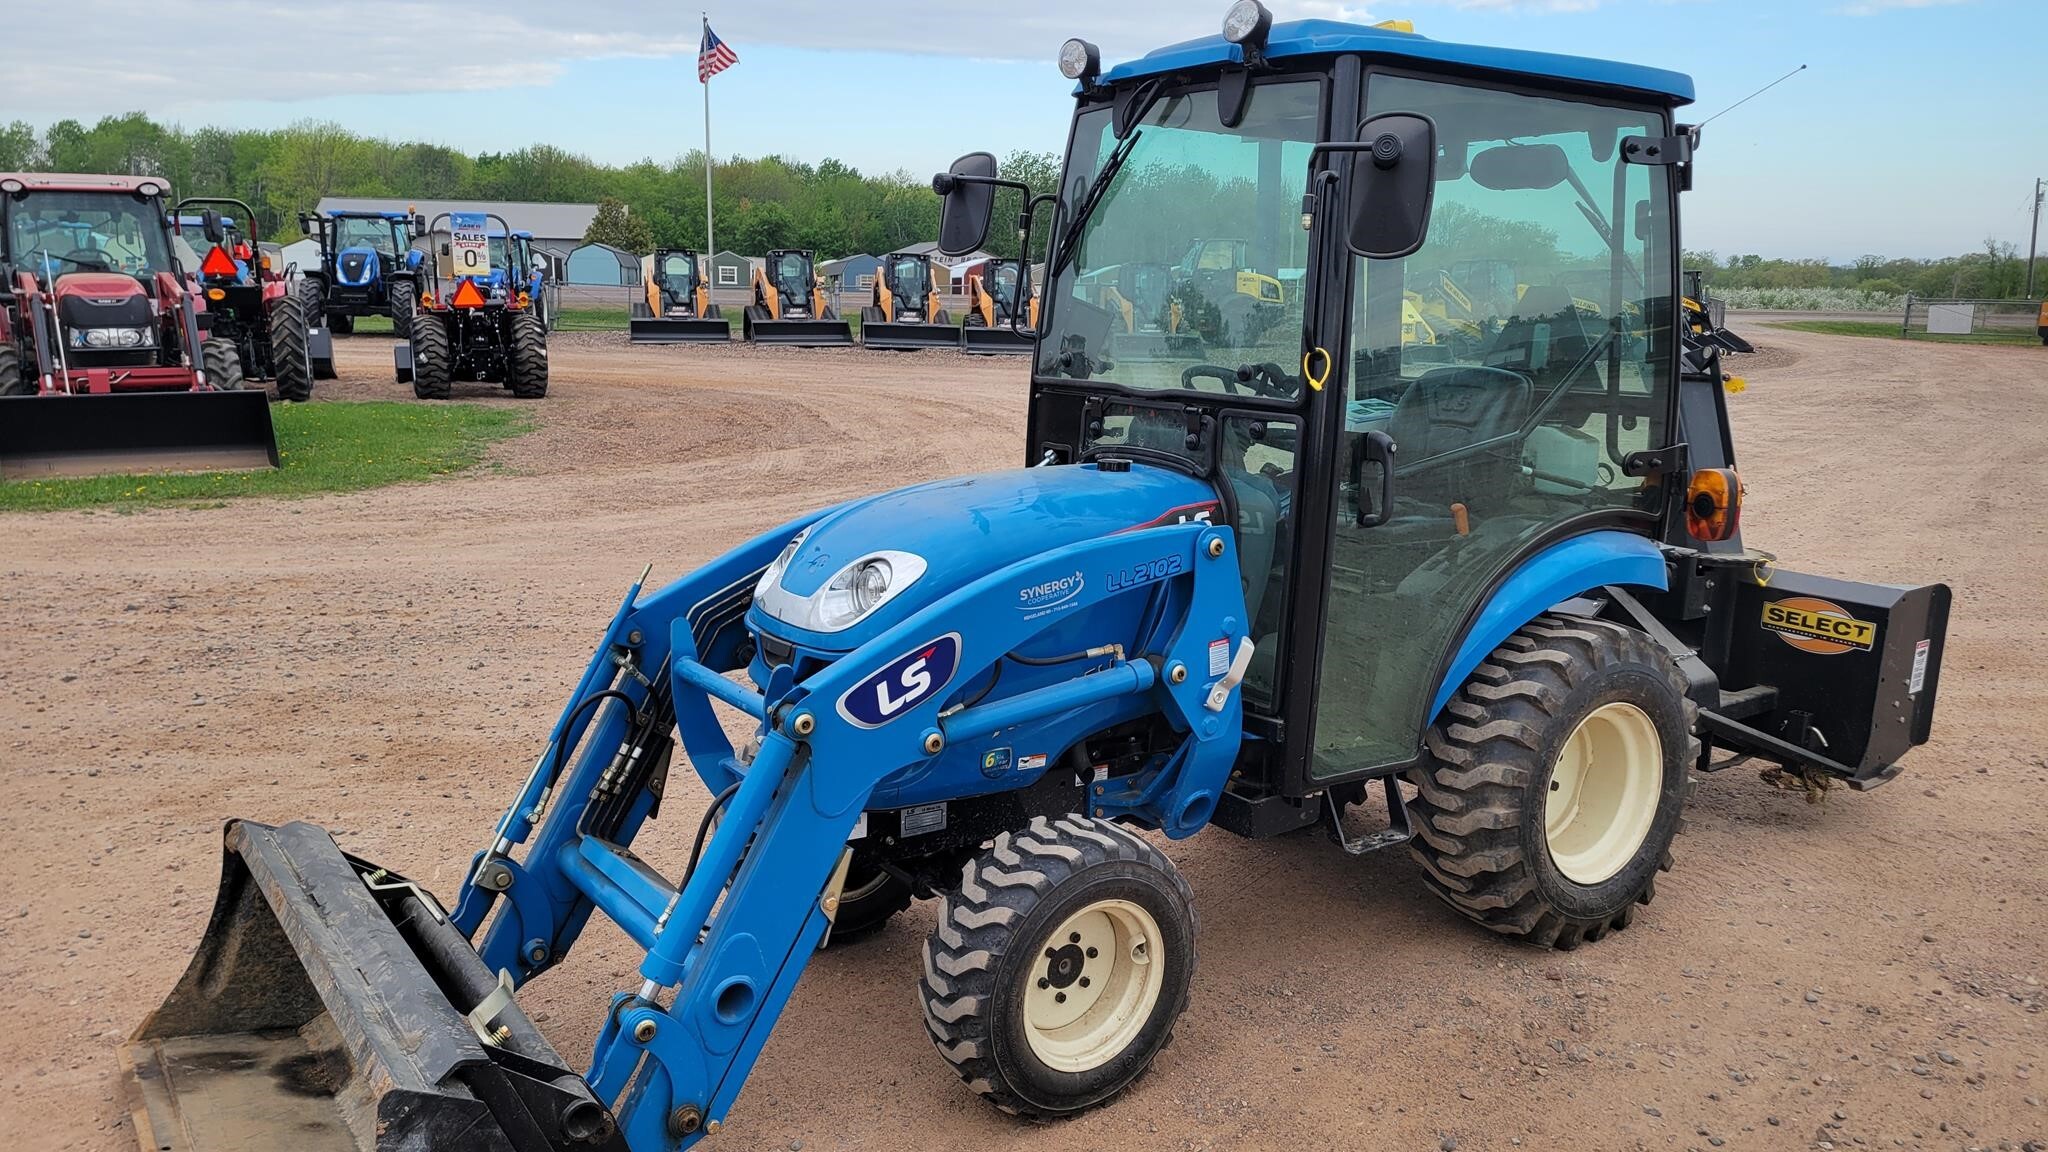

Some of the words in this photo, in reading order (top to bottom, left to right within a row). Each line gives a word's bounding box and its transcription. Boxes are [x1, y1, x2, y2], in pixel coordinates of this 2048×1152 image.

[453, 232, 486, 242] SALES
[1105, 553, 1183, 593] LL2102
[1020, 576, 1076, 601] SYNERGY
[1027, 588, 1070, 606] COOPERATIVE
[1767, 606, 1870, 638] SELECT
[876, 657, 931, 716] LS
